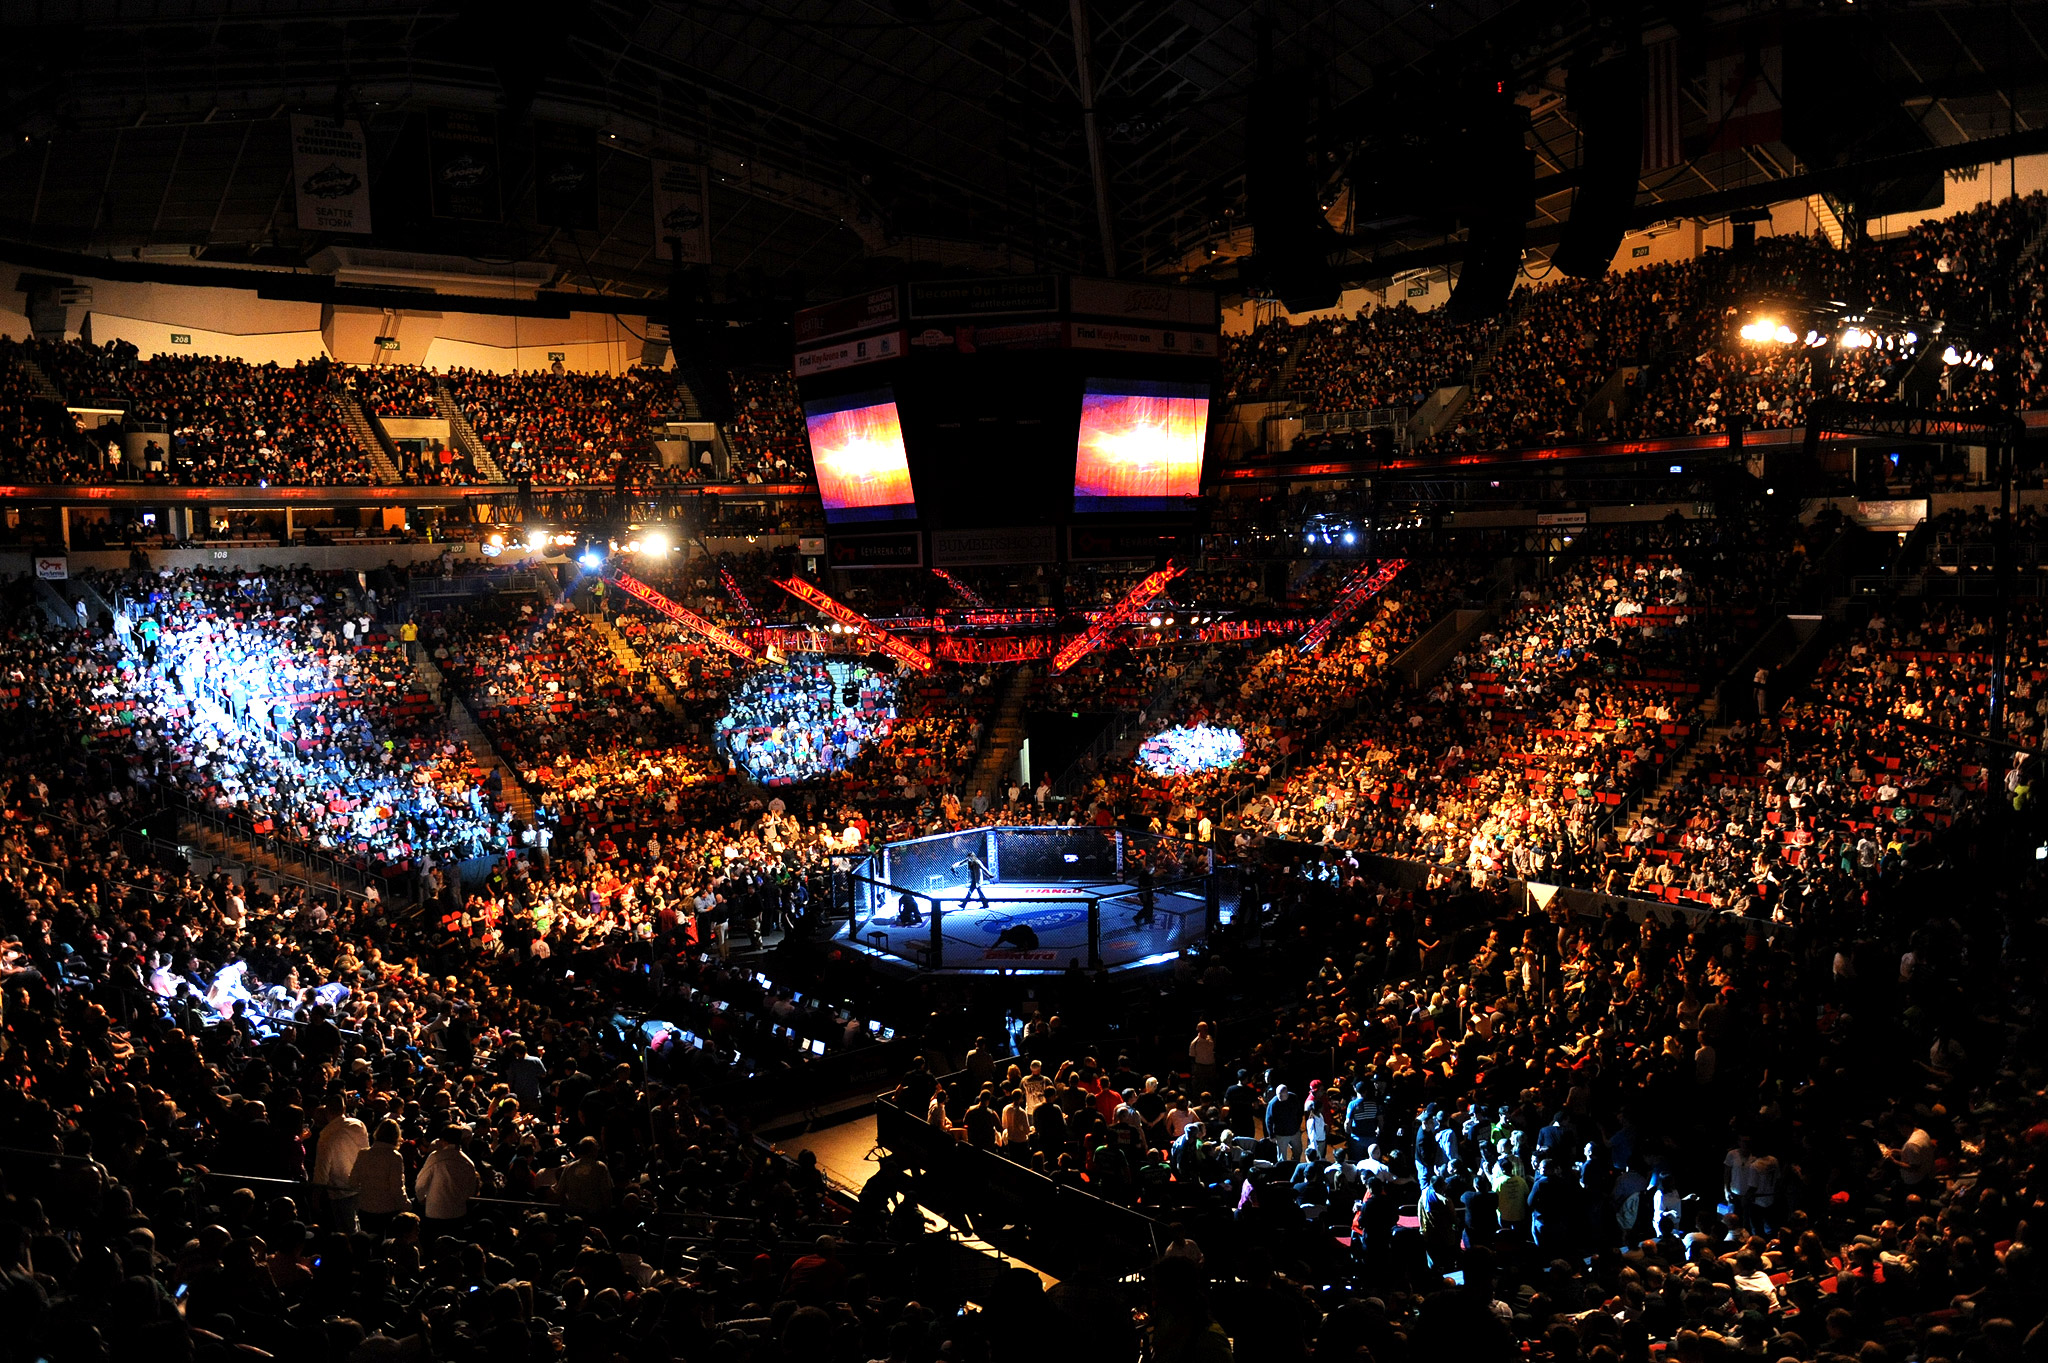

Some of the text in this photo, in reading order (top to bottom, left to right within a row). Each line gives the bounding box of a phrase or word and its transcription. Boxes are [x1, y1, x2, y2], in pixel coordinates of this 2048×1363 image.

[304, 127, 353, 140] WESTERN
[431, 130, 495, 145] CHAMPIONS
[296, 136, 362, 151] CONFERENCE
[298, 146, 362, 159] CHAMPIONS
[316, 207, 354, 218] SEATTLE
[318, 217, 353, 228] STORM
[1635, 248, 1648, 256] 201
[972, 285, 996, 297] Our
[867, 291, 893, 304] SEASON
[867, 301, 893, 314] TICKETS
[1077, 327, 1096, 339] Find
[1097, 329, 1138, 342] KeyArena
[1139, 334, 1151, 343] on
[799, 356, 811, 367] Find
[811, 351, 840, 365] KeyArena
[839, 350, 848, 359] on
[1623, 442, 1647, 453] UFC
[1538, 449, 1559, 459] UFC
[1459, 455, 1481, 465] UFC
[1235, 469, 1255, 478] UFC
[1309, 464, 1331, 474] UFC
[0, 486, 16, 497] FC
[88, 487, 117, 498] UFC
[187, 488, 210, 498] UFC
[281, 488, 307, 498] UFC
[373, 488, 397, 498] UFC
[778, 485, 800, 495] UFC
[938, 536, 1051, 552] BUMBERSHOOT
[213, 551, 228, 559] 108
[860, 545, 912, 557] KEYARENA.COM
[39, 570, 65, 578] KeyArena
